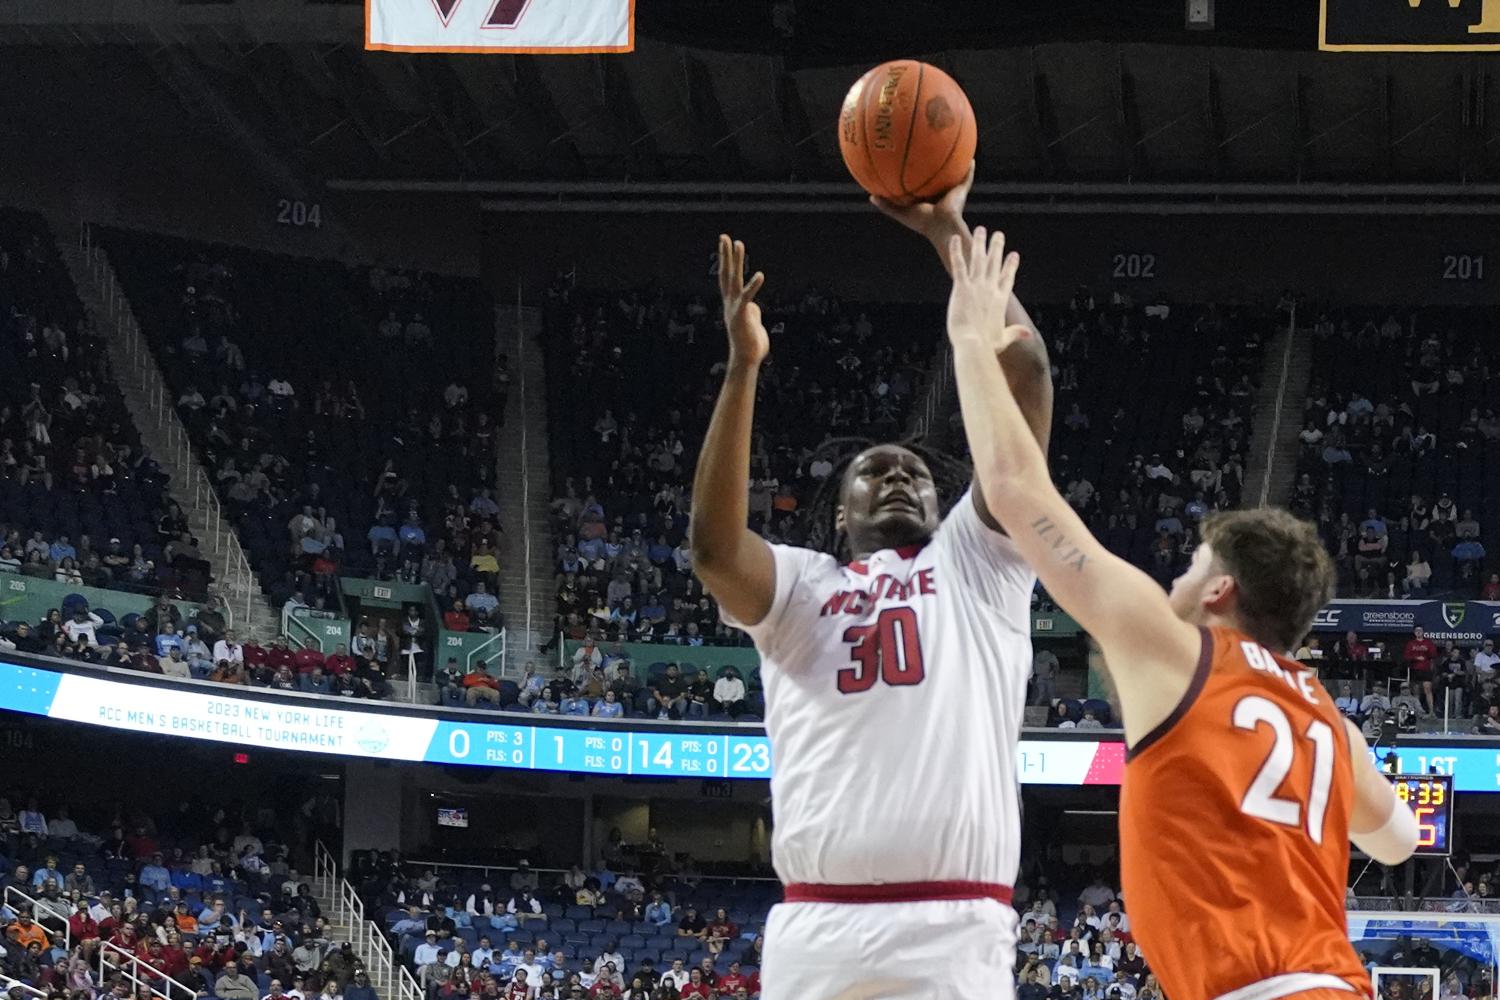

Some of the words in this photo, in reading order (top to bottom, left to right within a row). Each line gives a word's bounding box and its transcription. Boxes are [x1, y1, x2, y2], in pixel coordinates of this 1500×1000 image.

[276, 200, 321, 229] 204
[1112, 255, 1155, 278] 202
[1443, 256, 1485, 279] 201
[9, 580, 26, 591] 205
[1363, 610, 1415, 622] greensboro
[326, 626, 342, 636] 204
[447, 637, 463, 647] 204
[1424, 632, 1483, 640] GREENSBORO
[837, 606, 925, 695] 30
[99, 706, 122, 722] ACC
[172, 716, 252, 739] BASKETBALL
[258, 727, 344, 747] TOURNAMENT
[208, 701, 240, 718] 2023
[244, 707, 273, 722] NEW
[277, 711, 310, 727] YORK
[315, 715, 345, 729] LIFE
[449, 730, 470, 758] 0
[487, 731, 508, 743] PTS:
[513, 732, 523, 745] 3
[585, 737, 606, 749] PTS:
[611, 738, 622, 752] 0
[681, 741, 702, 753] PTS:
[707, 741, 718, 755] 0
[486, 750, 507, 762] FLS:
[512, 750, 523, 764] 0
[553, 736, 564, 764] 1
[639, 740, 673, 769] 14
[733, 744, 770, 772] 23
[585, 756, 605, 768] FLS:
[611, 756, 622, 770] 0
[681, 759, 701, 771] FLS:
[706, 759, 717, 773] 0
[1233, 695, 1334, 846] 21
[1391, 782, 1444, 805] 8:33
